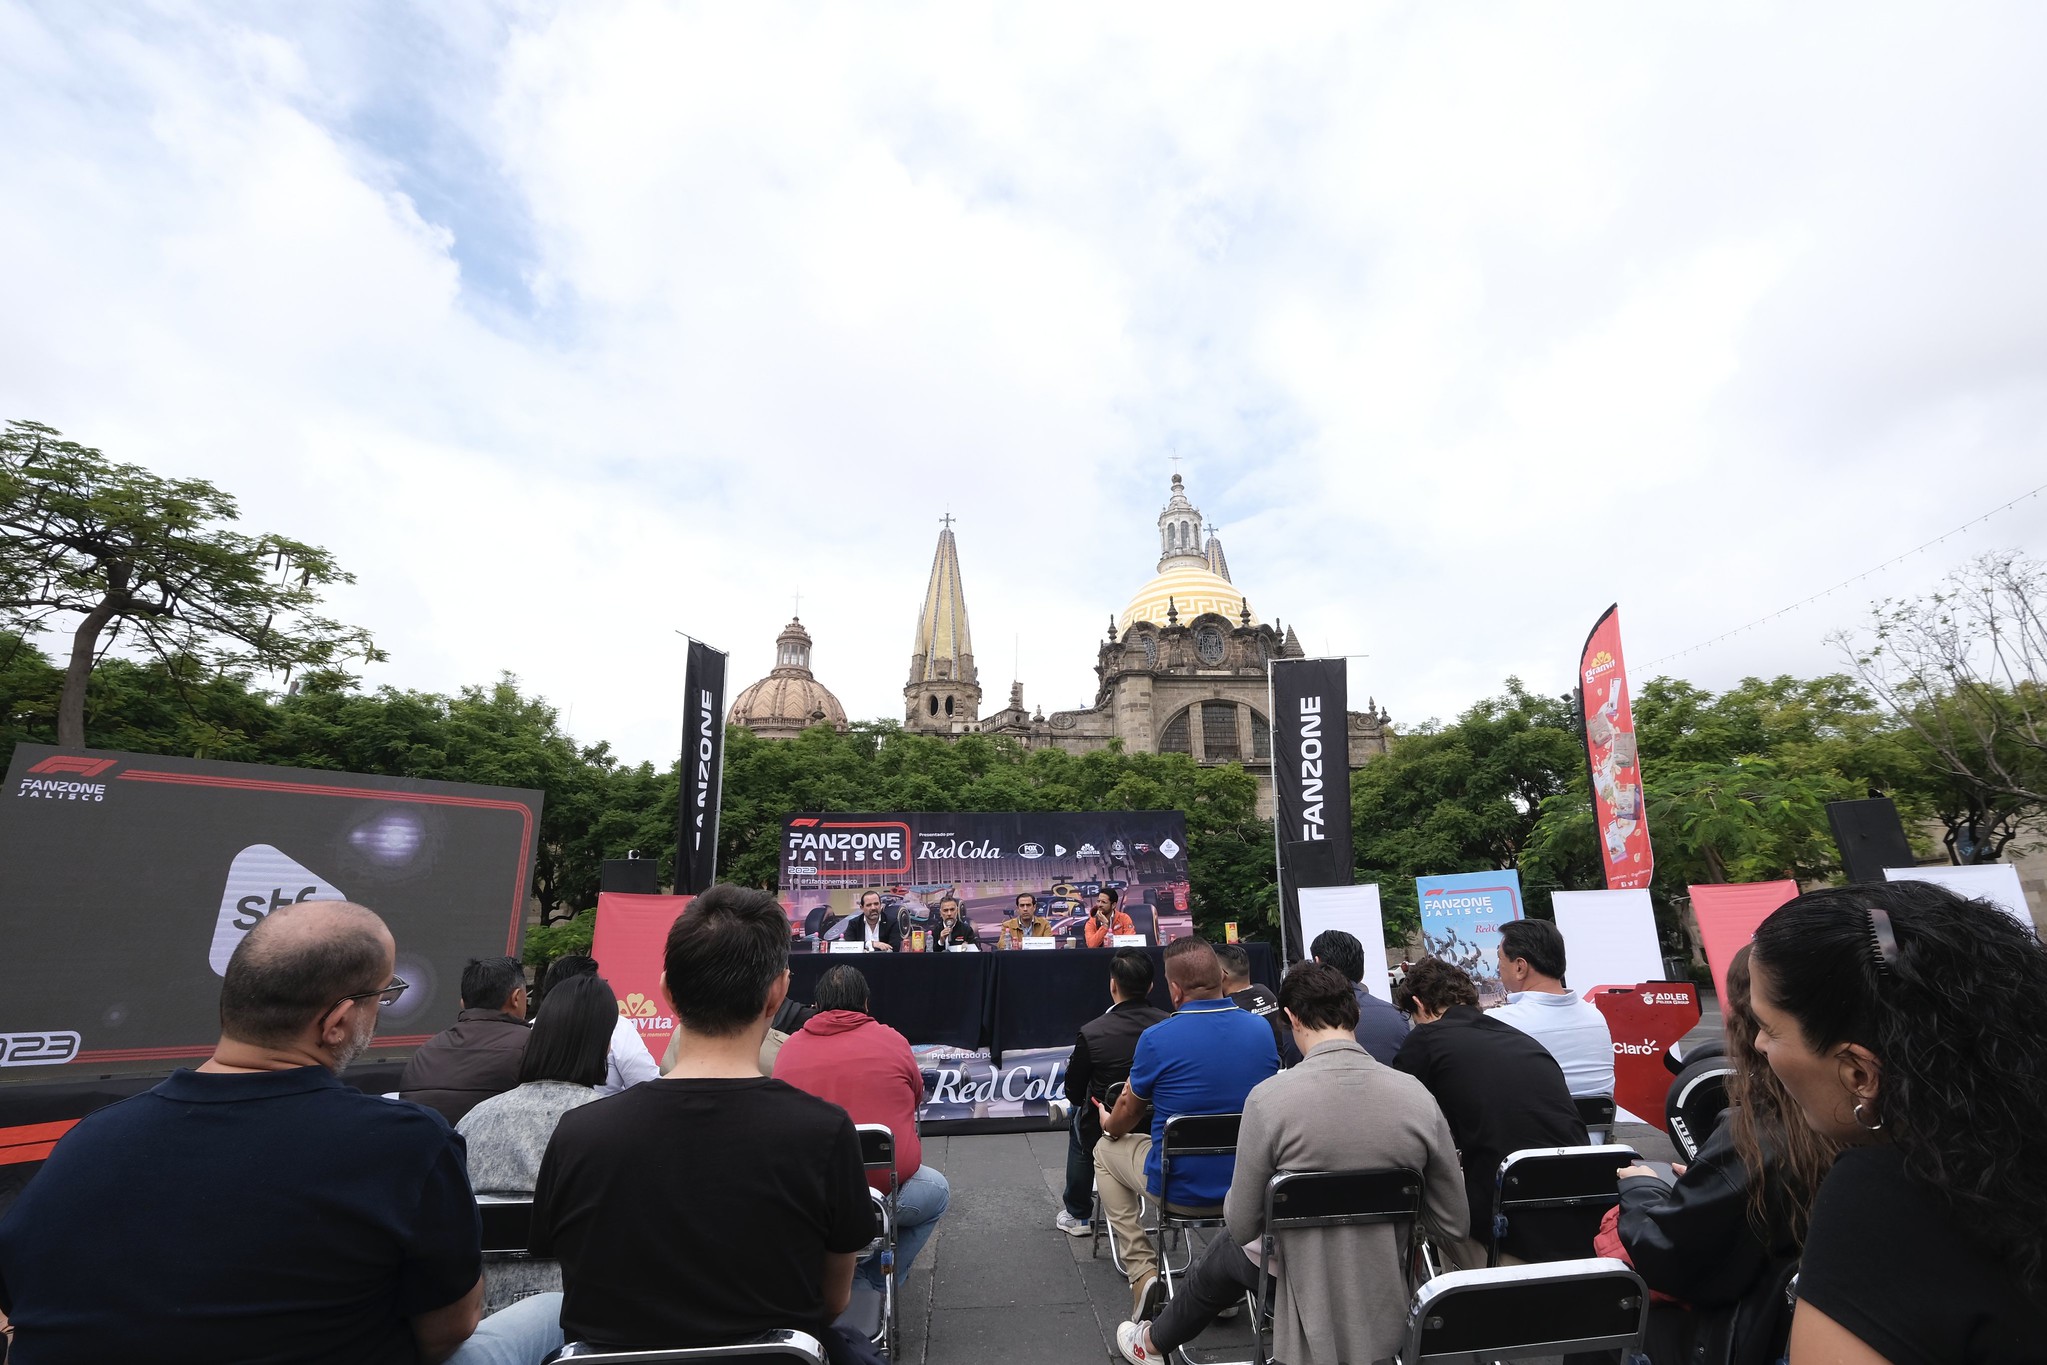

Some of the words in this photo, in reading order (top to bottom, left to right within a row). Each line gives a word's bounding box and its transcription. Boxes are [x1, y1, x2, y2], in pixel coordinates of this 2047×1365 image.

[1585, 659, 1616, 684] granvit
[1300, 696, 1325, 841] FANZONE
[21, 779, 106, 794] FANZONE
[17, 790, 104, 802] JALISCO
[789, 832, 900, 850] FANZONE
[788, 850, 902, 862] JALISCO
[1424, 896, 1492, 910] FANZONE
[1426, 907, 1494, 917] JALISCO
[1656, 993, 1689, 1001] ADLER
[628, 1015, 673, 1030] nvita
[0, 1035, 76, 1062] 23
[1612, 1040, 1654, 1056] Claro
[931, 1051, 981, 1060] Presentado
[981, 1053, 992, 1061] po
